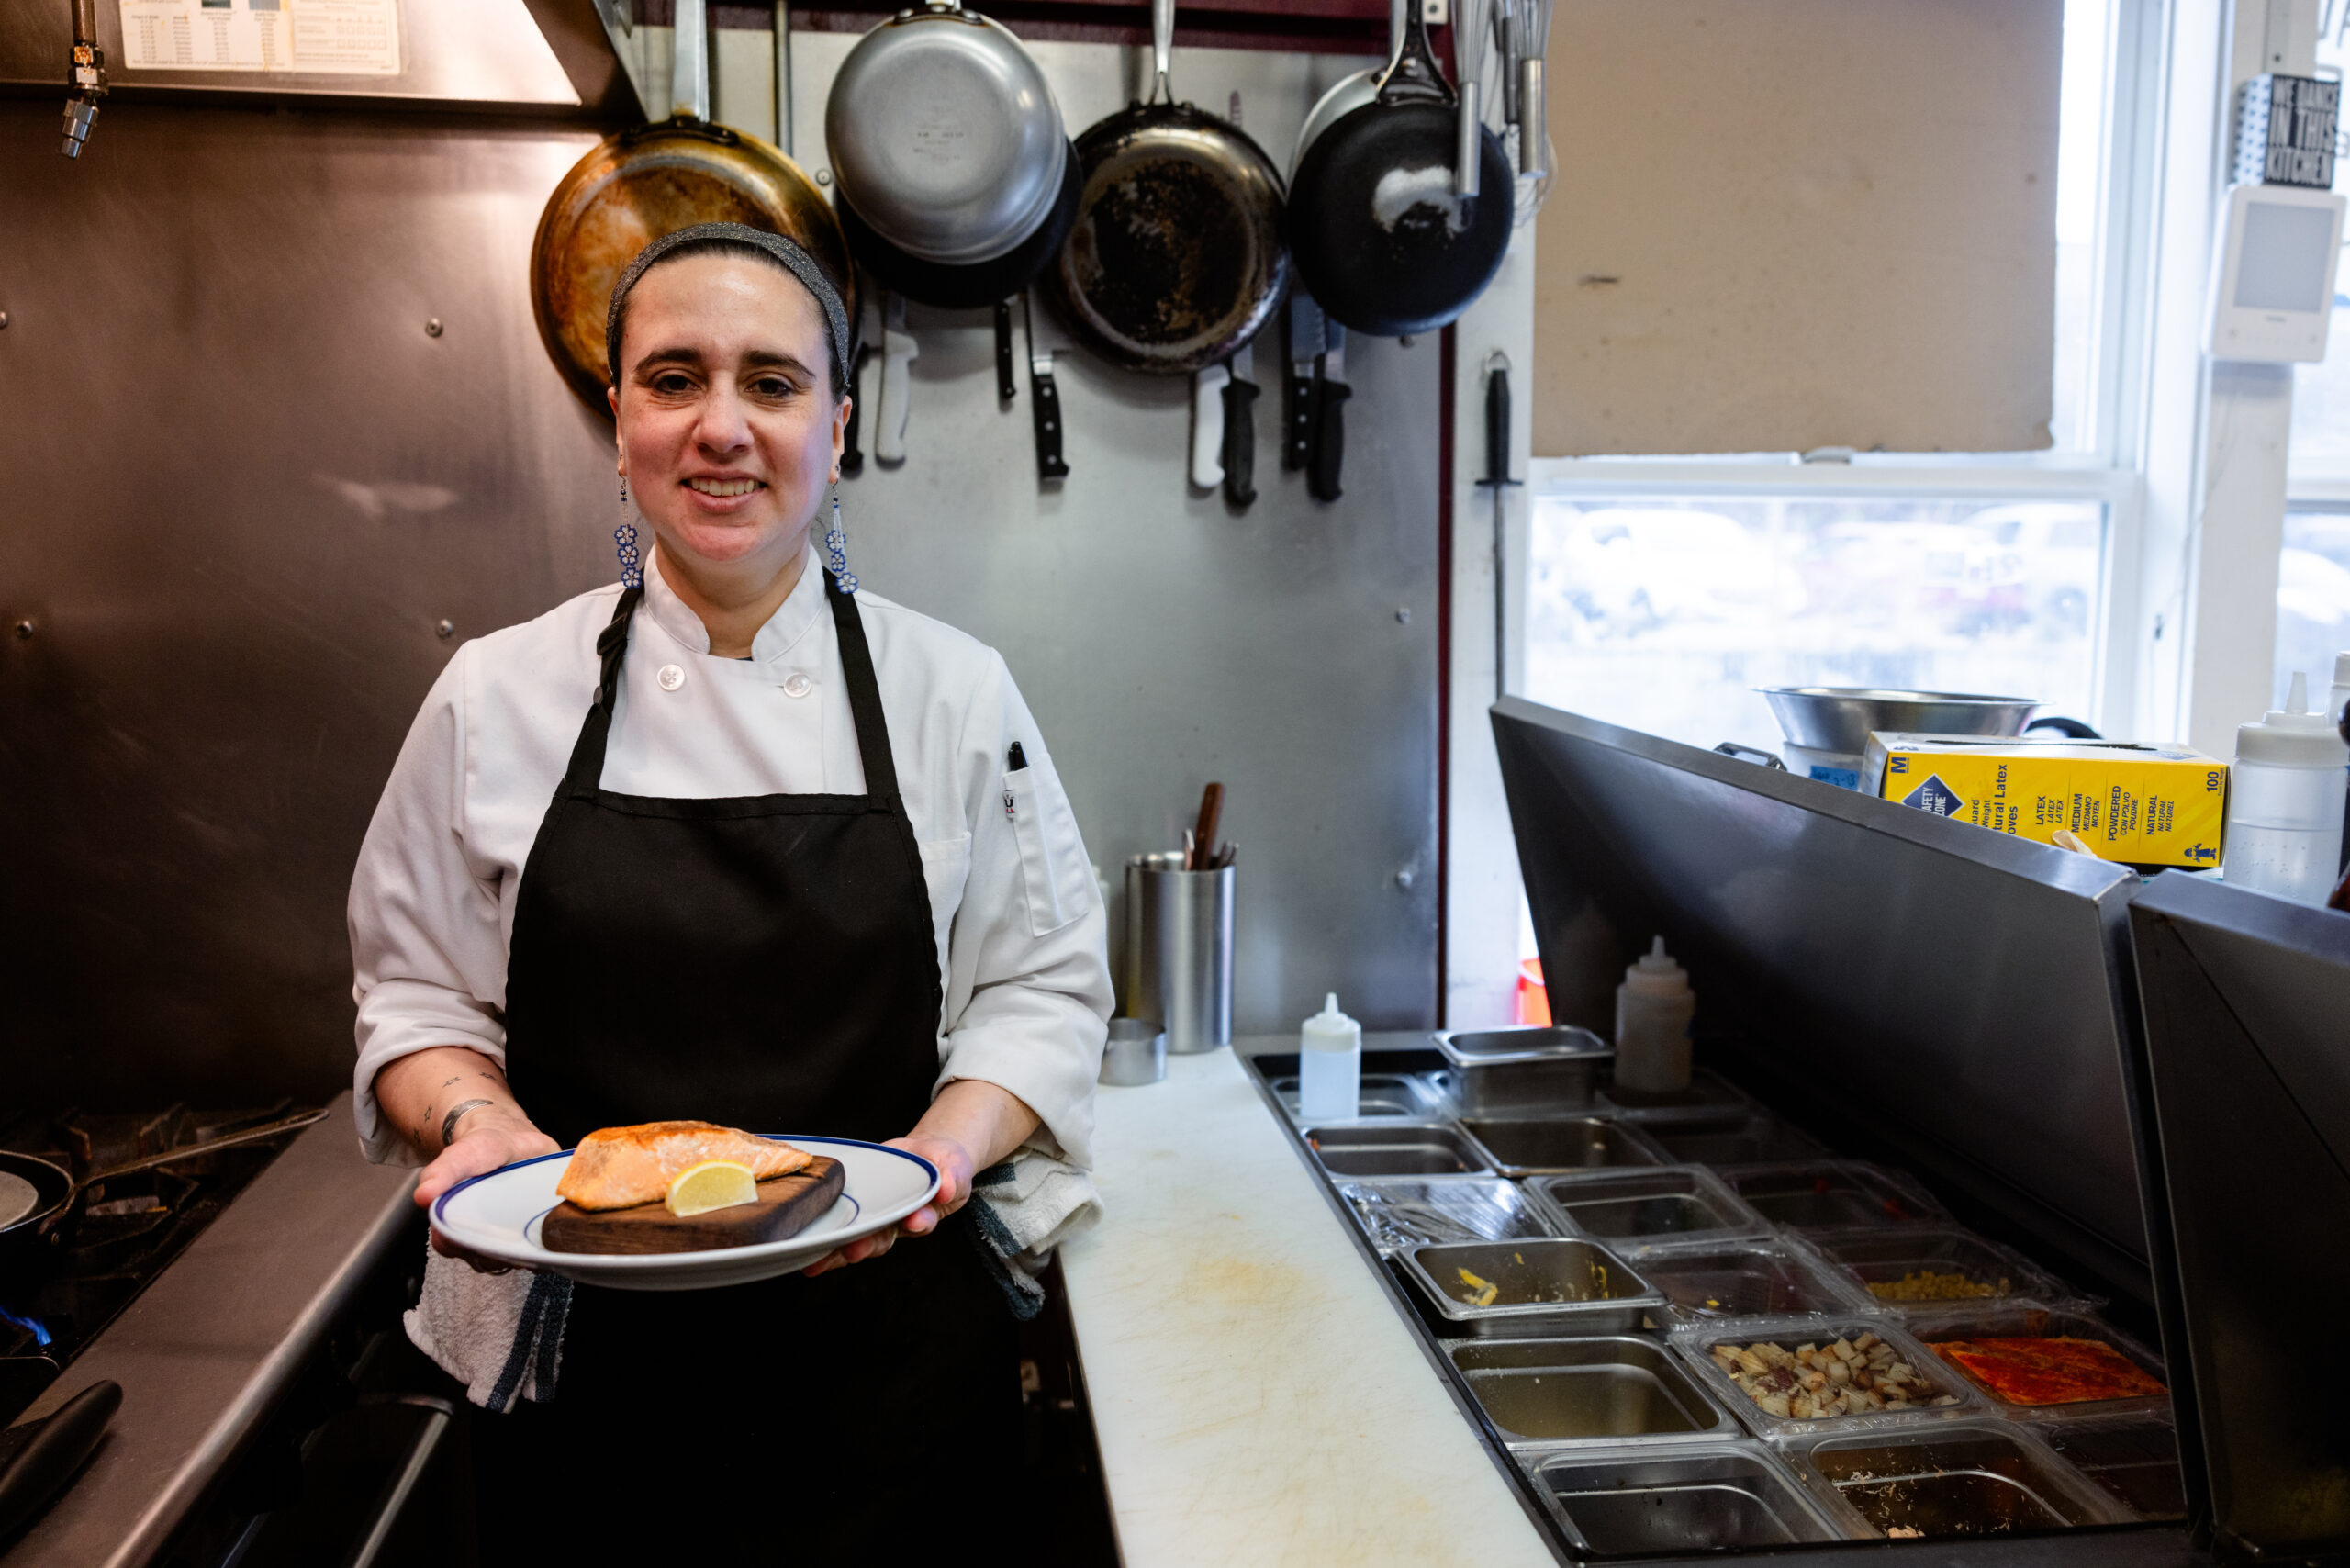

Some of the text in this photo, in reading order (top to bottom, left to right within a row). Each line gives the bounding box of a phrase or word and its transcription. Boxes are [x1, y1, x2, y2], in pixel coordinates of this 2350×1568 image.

[2295, 109, 2337, 152] THIS
[2266, 148, 2334, 186] KITCHEN
[1890, 756, 1907, 774] M
[1992, 764, 2008, 831] tural Latex
[2206, 771, 2219, 792] 100
[1921, 787, 1934, 812] AFETY
[2035, 796, 2046, 825] LATEX
[2055, 800, 2064, 823] LATEX
[2071, 793, 2083, 833] MEDIUM
[2083, 796, 2092, 831] MEDIANO
[2091, 801, 2100, 828] MOYEN
[2108, 785, 2121, 841] POWDERED
[2120, 791, 2131, 835] CON POLVO
[2146, 795, 2158, 835] NATURAL
[2008, 806, 2018, 835] oves
[2157, 800, 2166, 832] NATURAL
[2165, 801, 2175, 832] NATUREL
